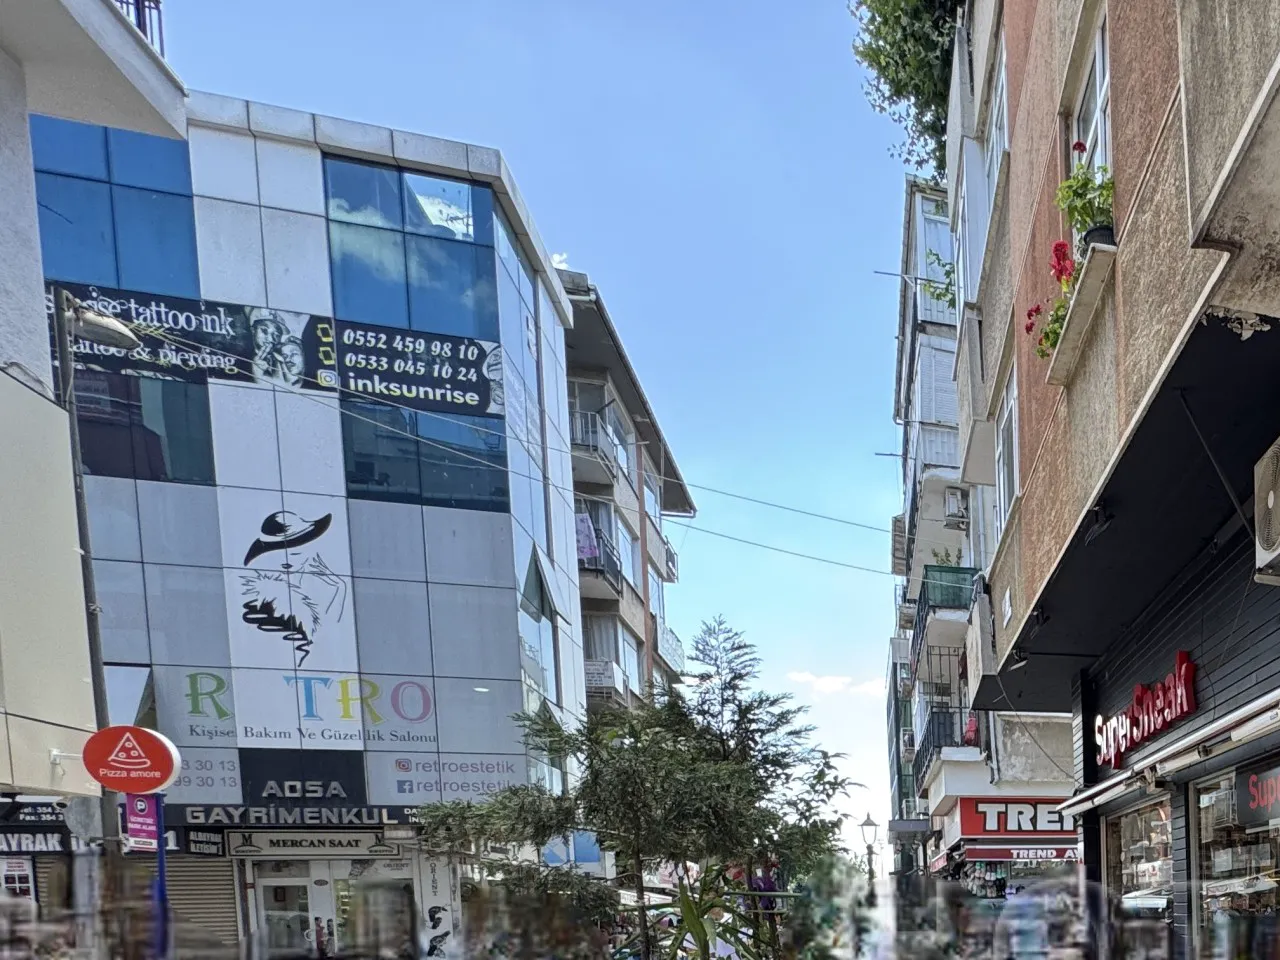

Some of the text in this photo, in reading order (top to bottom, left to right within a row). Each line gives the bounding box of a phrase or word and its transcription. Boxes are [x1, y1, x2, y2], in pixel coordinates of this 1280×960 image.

[128, 298, 196, 331] tattoo
[200, 301, 236, 338] ink
[343, 329, 478, 360] 0552 459 98 10
[158, 342, 239, 375] piercing
[344, 352, 477, 382] 0533 045 10 24
[349, 373, 480, 405] inksunrise
[1095, 650, 1196, 769] SuperSneak
[244, 726, 291, 739] Bakım
[297, 728, 316, 739] Ve
[390, 730, 437, 743] Salonu
[100, 768, 161, 778] Pizza amore
[195, 760, 213, 771] 30
[219, 761, 236, 771] 13
[415, 760, 515, 773] retroestetik
[196, 776, 214, 787] 30
[220, 777, 237, 787] 13
[186, 804, 398, 824] GAYRİMENKUL
[269, 839, 361, 848] MERCAN SAAT
[1011, 849, 1057, 859] TREND
